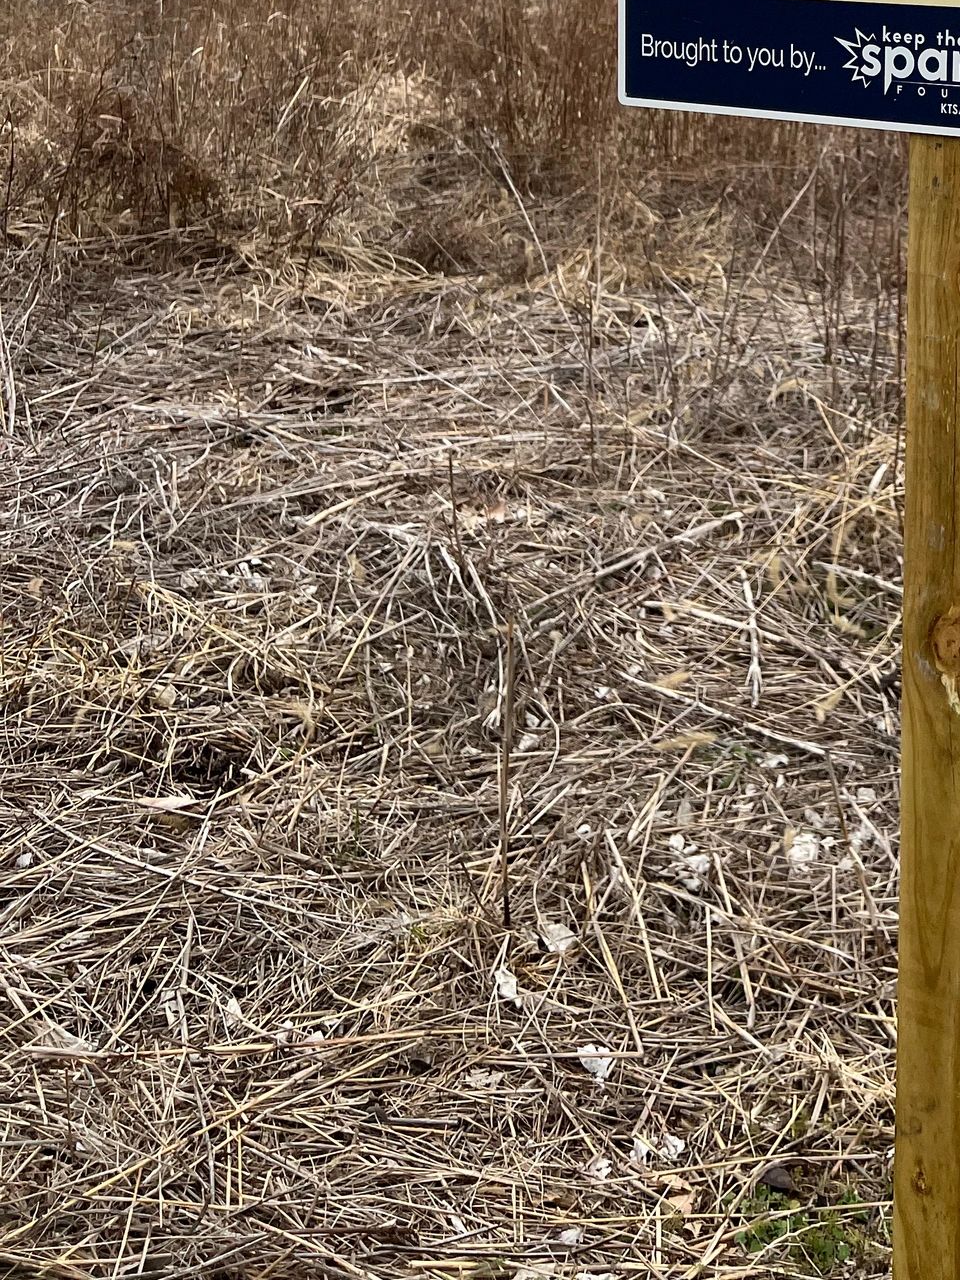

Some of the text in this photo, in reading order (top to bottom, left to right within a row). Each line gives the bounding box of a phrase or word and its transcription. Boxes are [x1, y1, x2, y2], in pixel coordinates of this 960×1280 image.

[882, 25, 925, 50] keep
[641, 33, 827, 77] Brought to you by...
